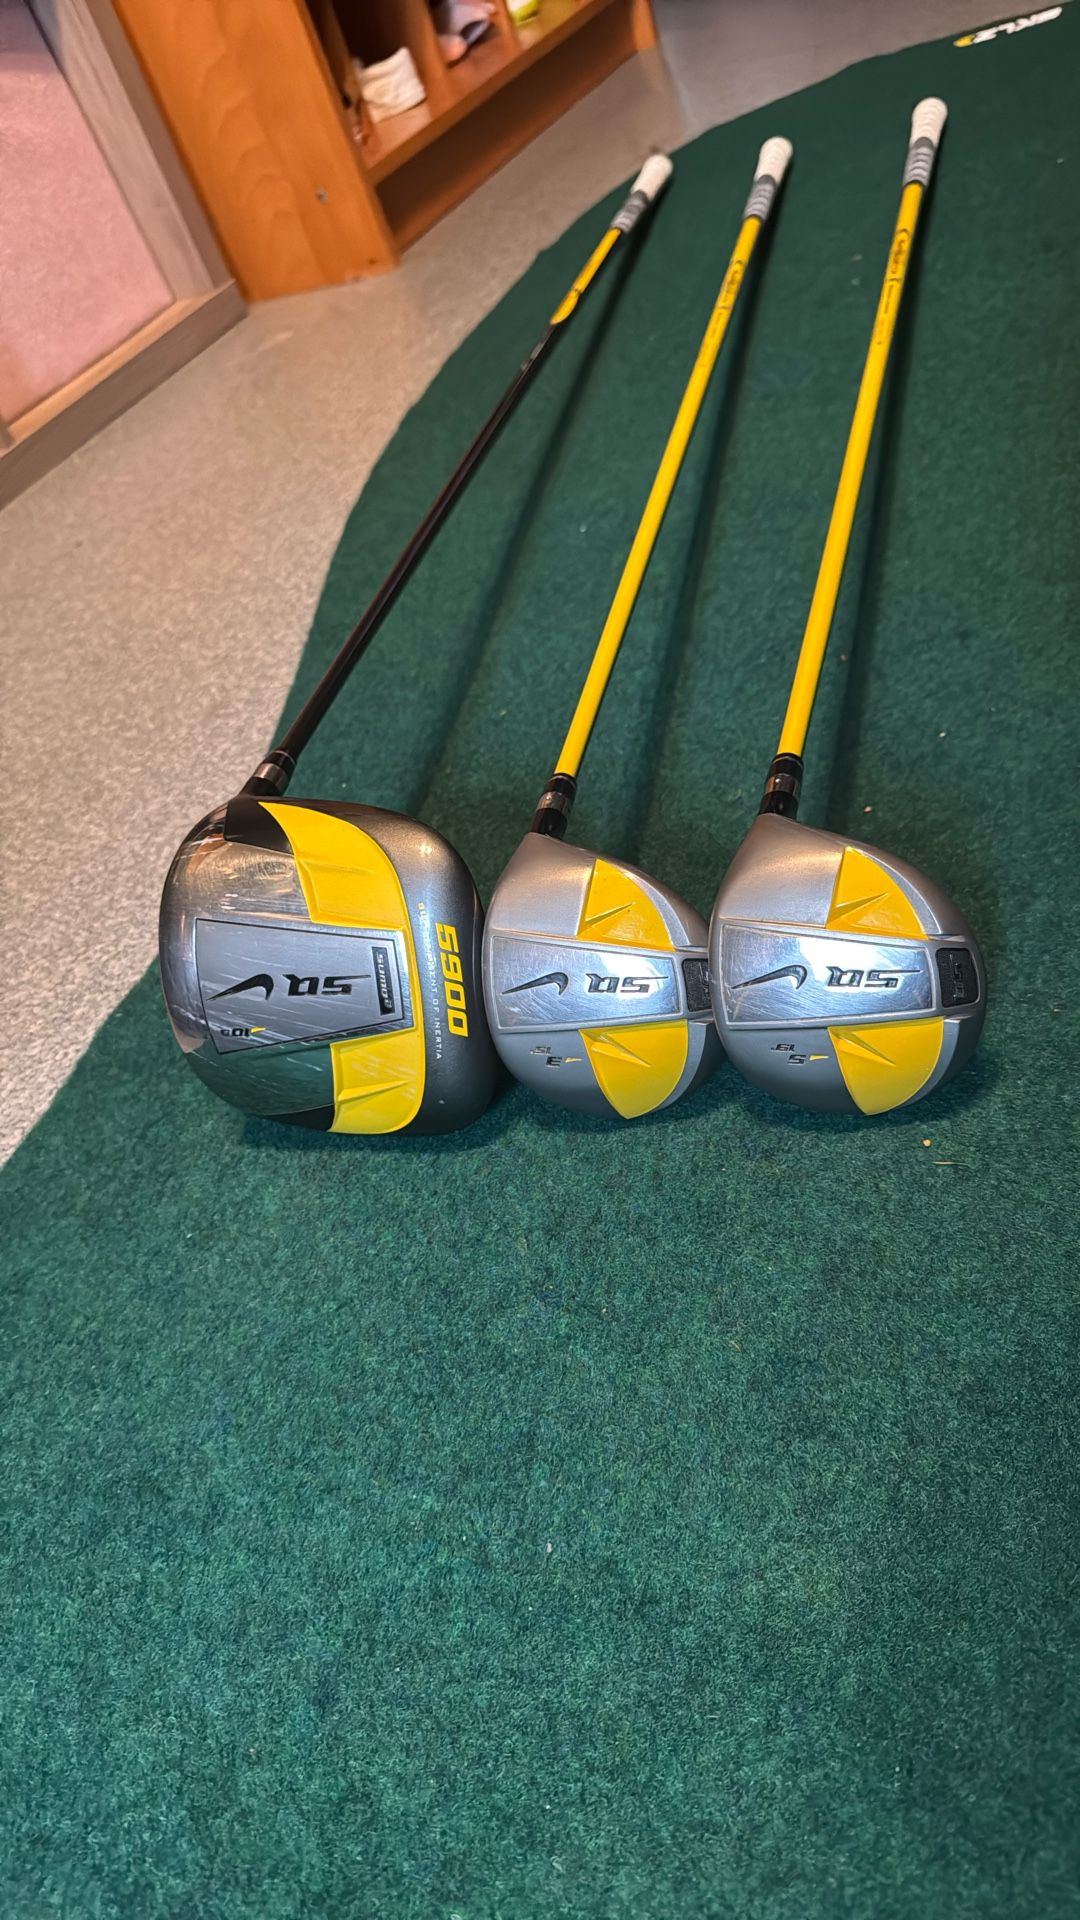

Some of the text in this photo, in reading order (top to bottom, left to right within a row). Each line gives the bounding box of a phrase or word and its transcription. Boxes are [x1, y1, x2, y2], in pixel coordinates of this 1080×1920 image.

[435, 922, 469, 1037] 5900
[432, 998, 440, 1013] OF
[434, 1018, 443, 1060] INERTIA
[546, 1056, 563, 1067] 3
[786, 1054, 807, 1065] 5
